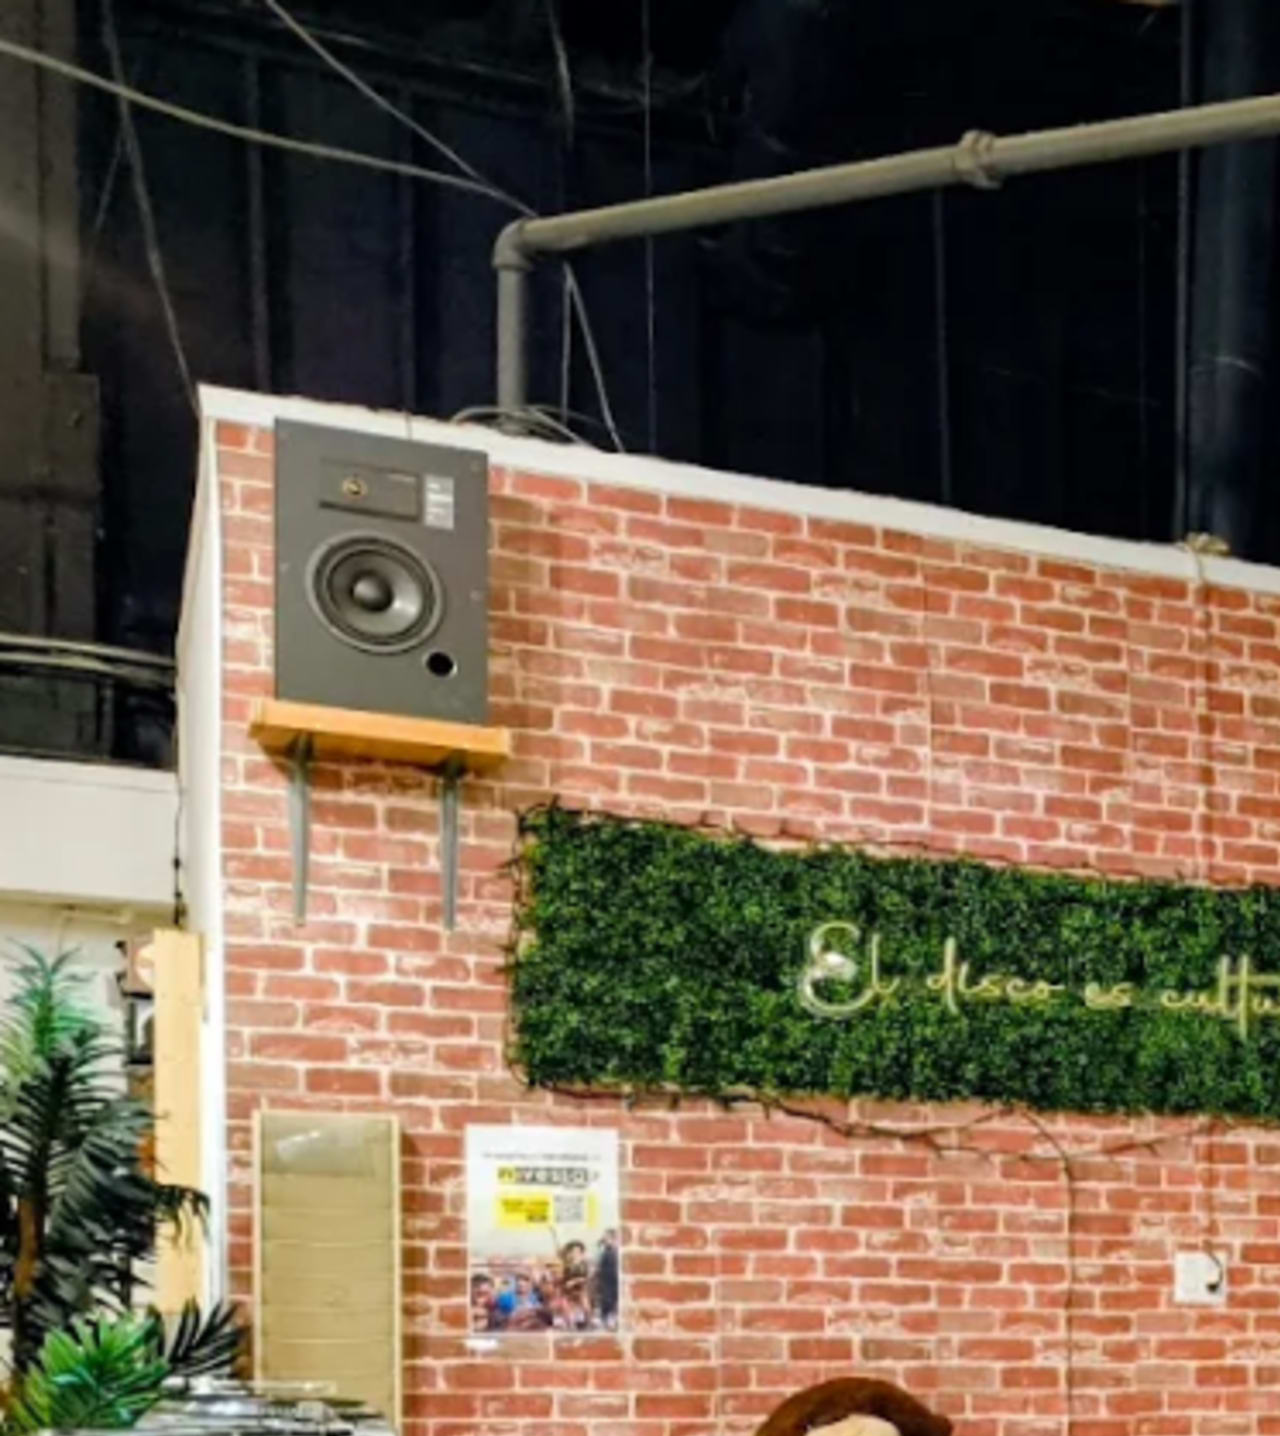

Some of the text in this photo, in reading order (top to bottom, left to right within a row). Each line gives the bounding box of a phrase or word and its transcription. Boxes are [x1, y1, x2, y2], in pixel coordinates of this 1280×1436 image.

[800, 921, 900, 1018] El
[926, 936, 1065, 1015] disco
[1084, 982, 1134, 1009] es
